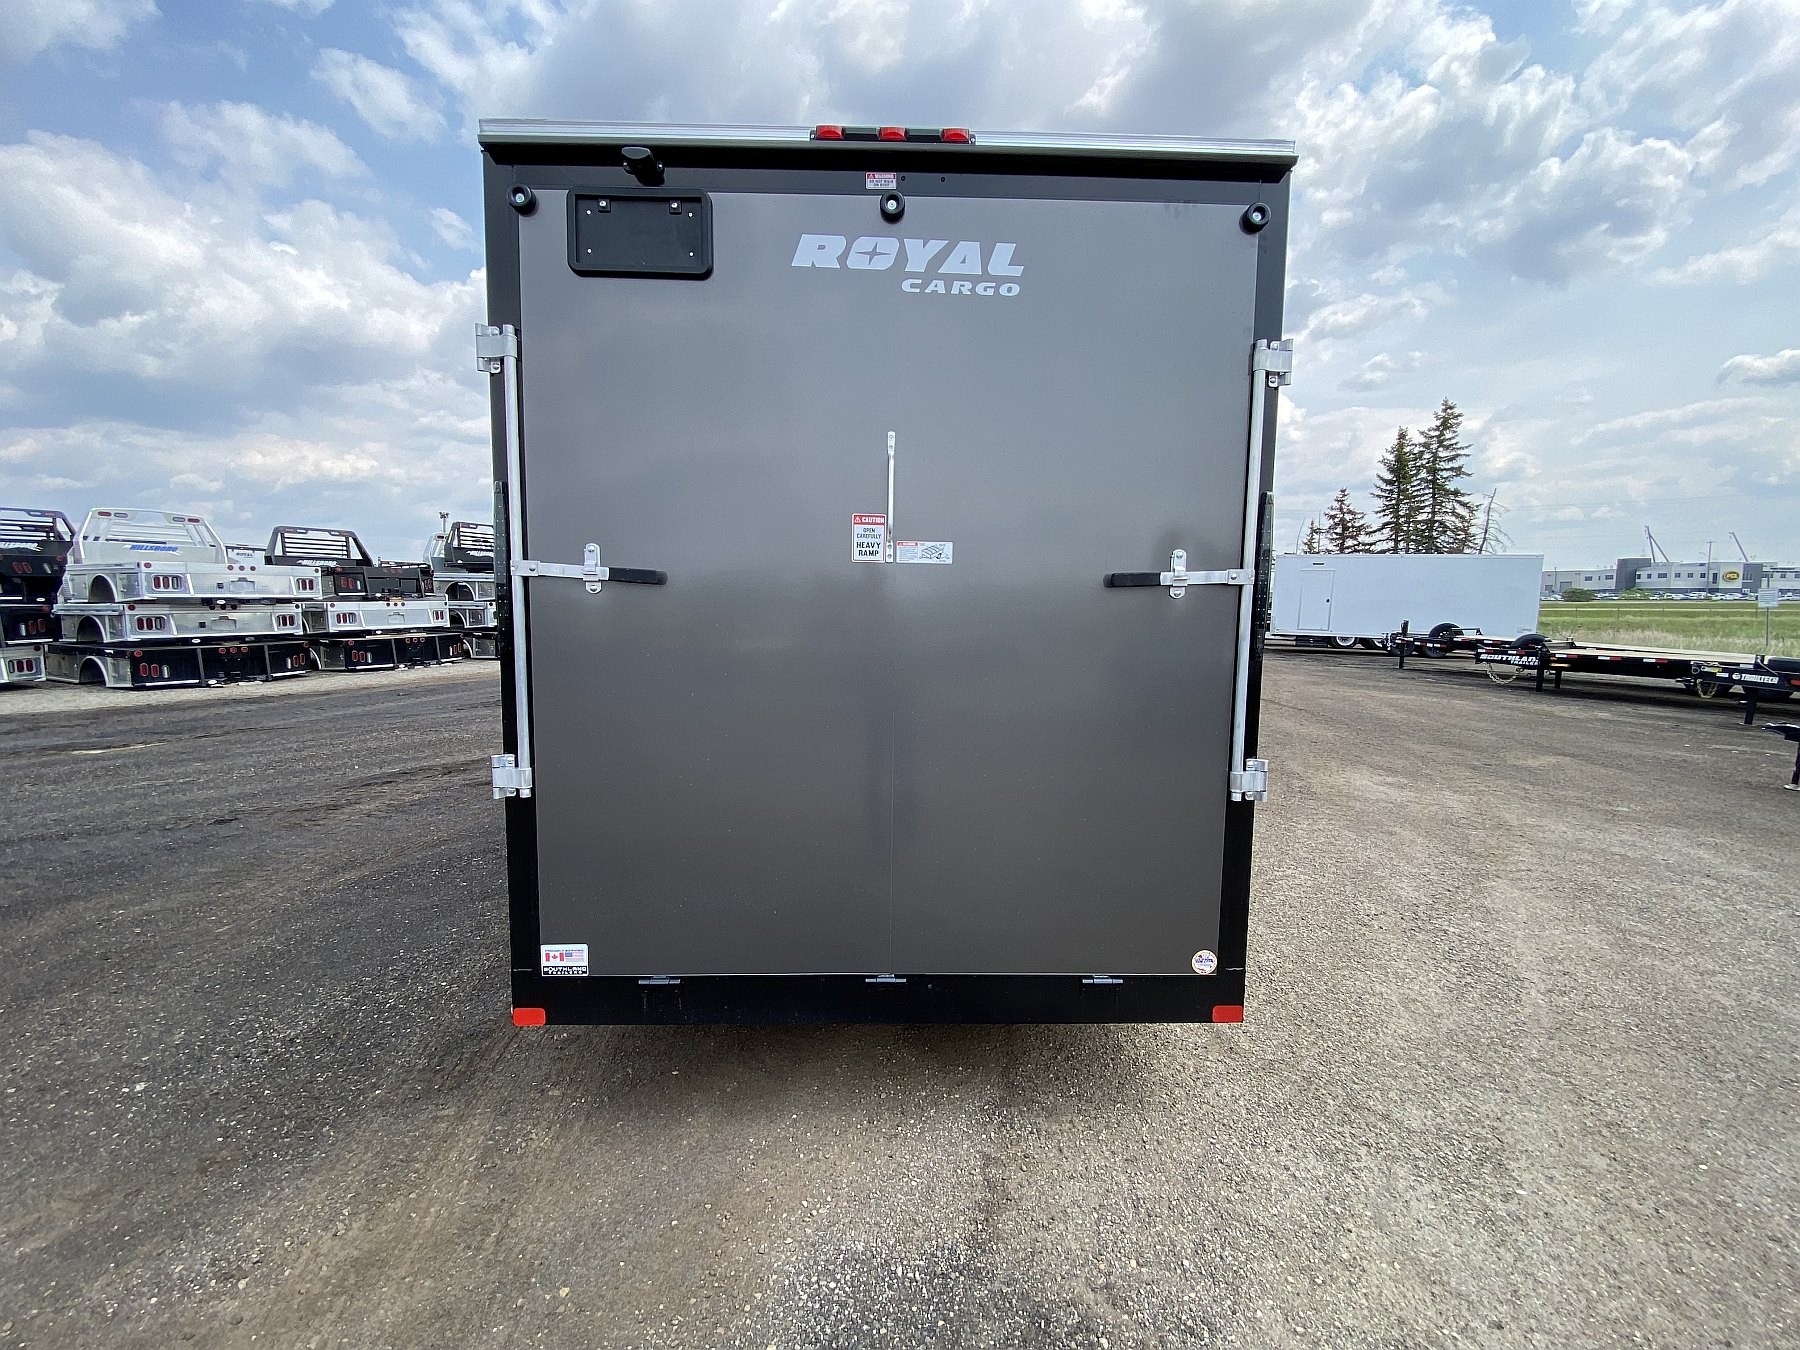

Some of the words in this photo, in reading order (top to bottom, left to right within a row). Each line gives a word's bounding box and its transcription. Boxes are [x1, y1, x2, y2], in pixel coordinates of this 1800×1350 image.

[791, 233, 1025, 277] ROYAL
[901, 278, 1021, 297] CARGO
[861, 516, 885, 524] CAUTION
[856, 541, 881, 549] HEAVY
[858, 549, 879, 557] RAMP
[1479, 653, 1538, 662] SOUTHLAN
